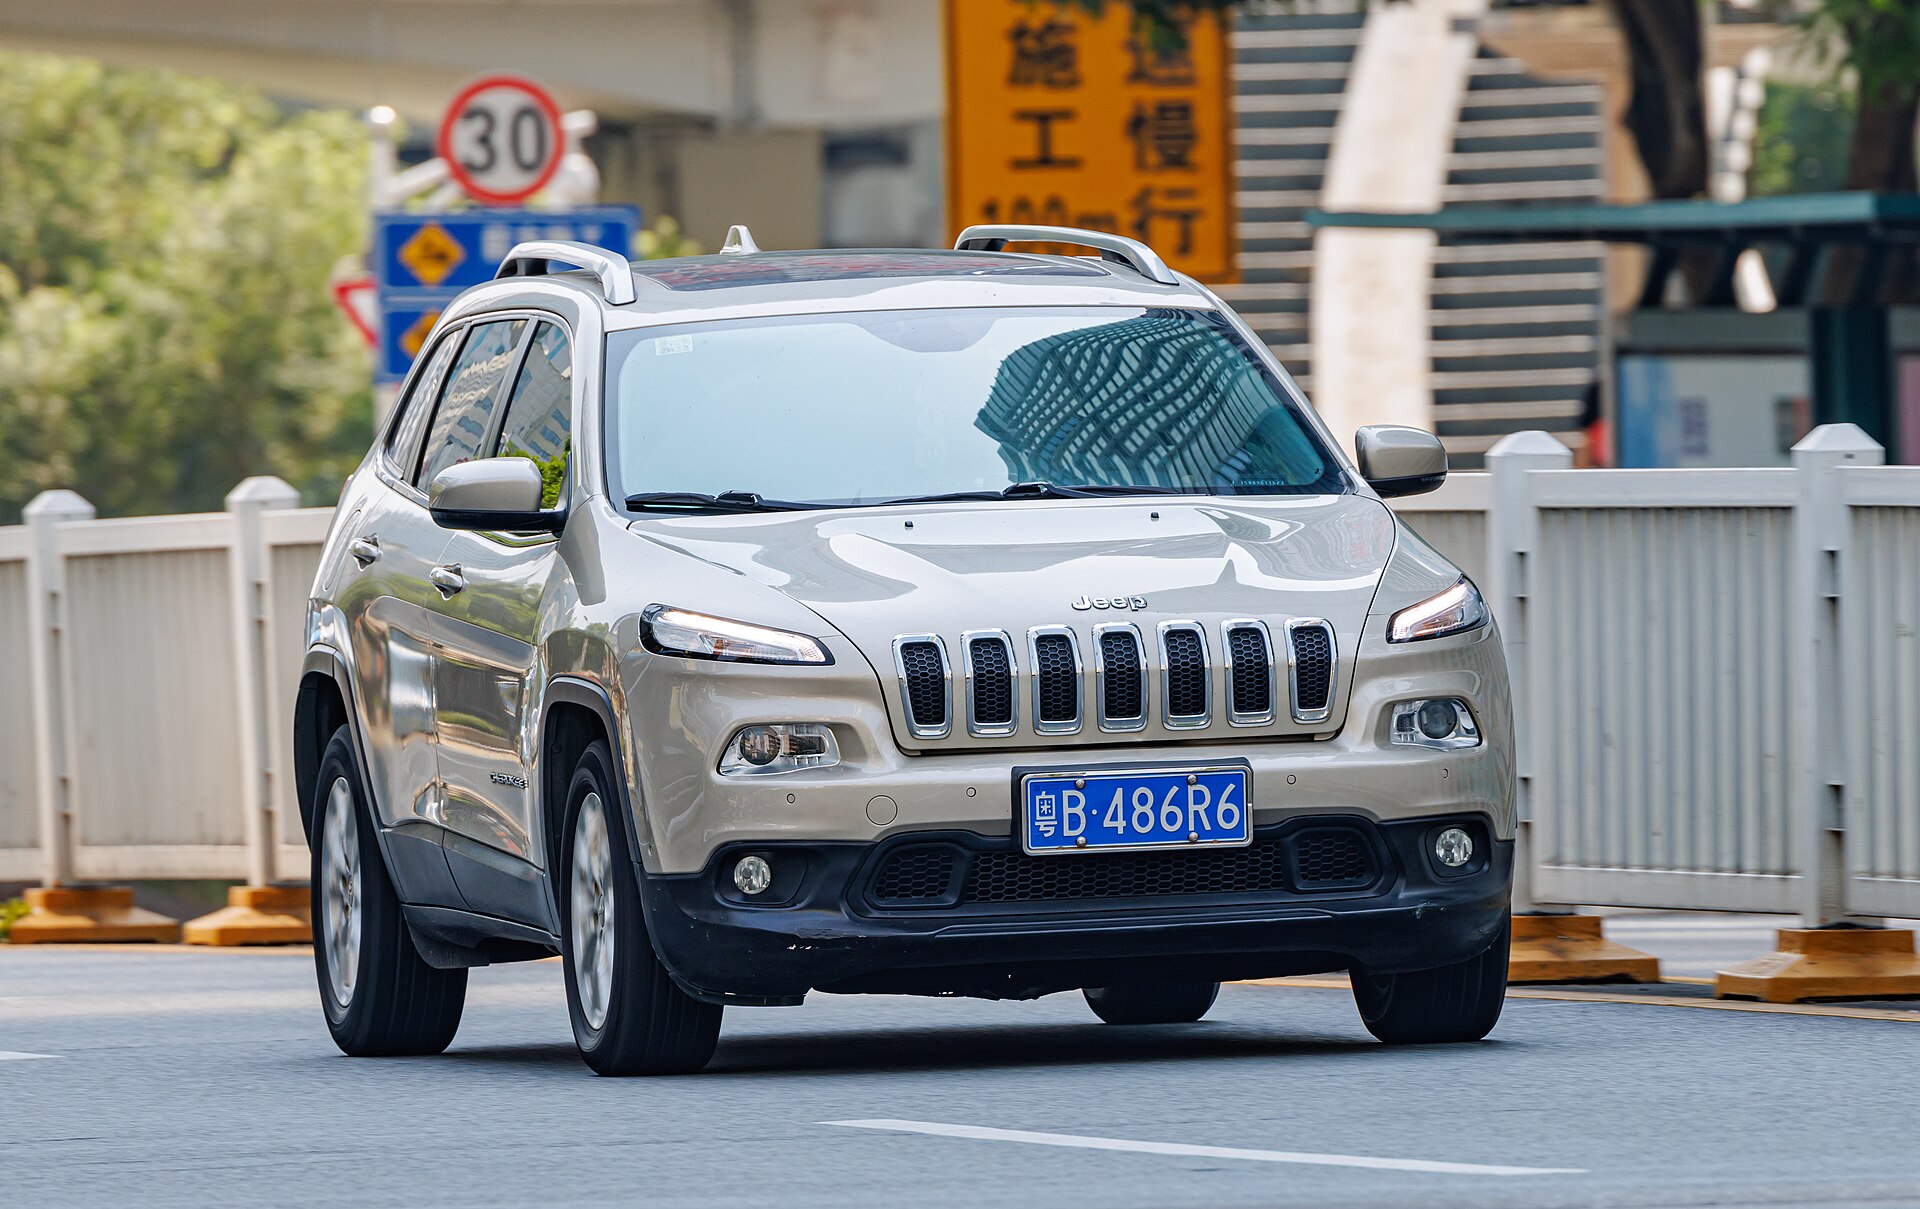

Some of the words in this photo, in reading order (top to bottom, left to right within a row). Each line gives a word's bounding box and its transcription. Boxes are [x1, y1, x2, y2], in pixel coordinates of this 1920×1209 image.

[1006, 19, 1083, 169] 施工
[463, 106, 545, 173] 30
[1071, 594, 1148, 611] Jeep
[489, 771, 529, 789] CHEROKEE
